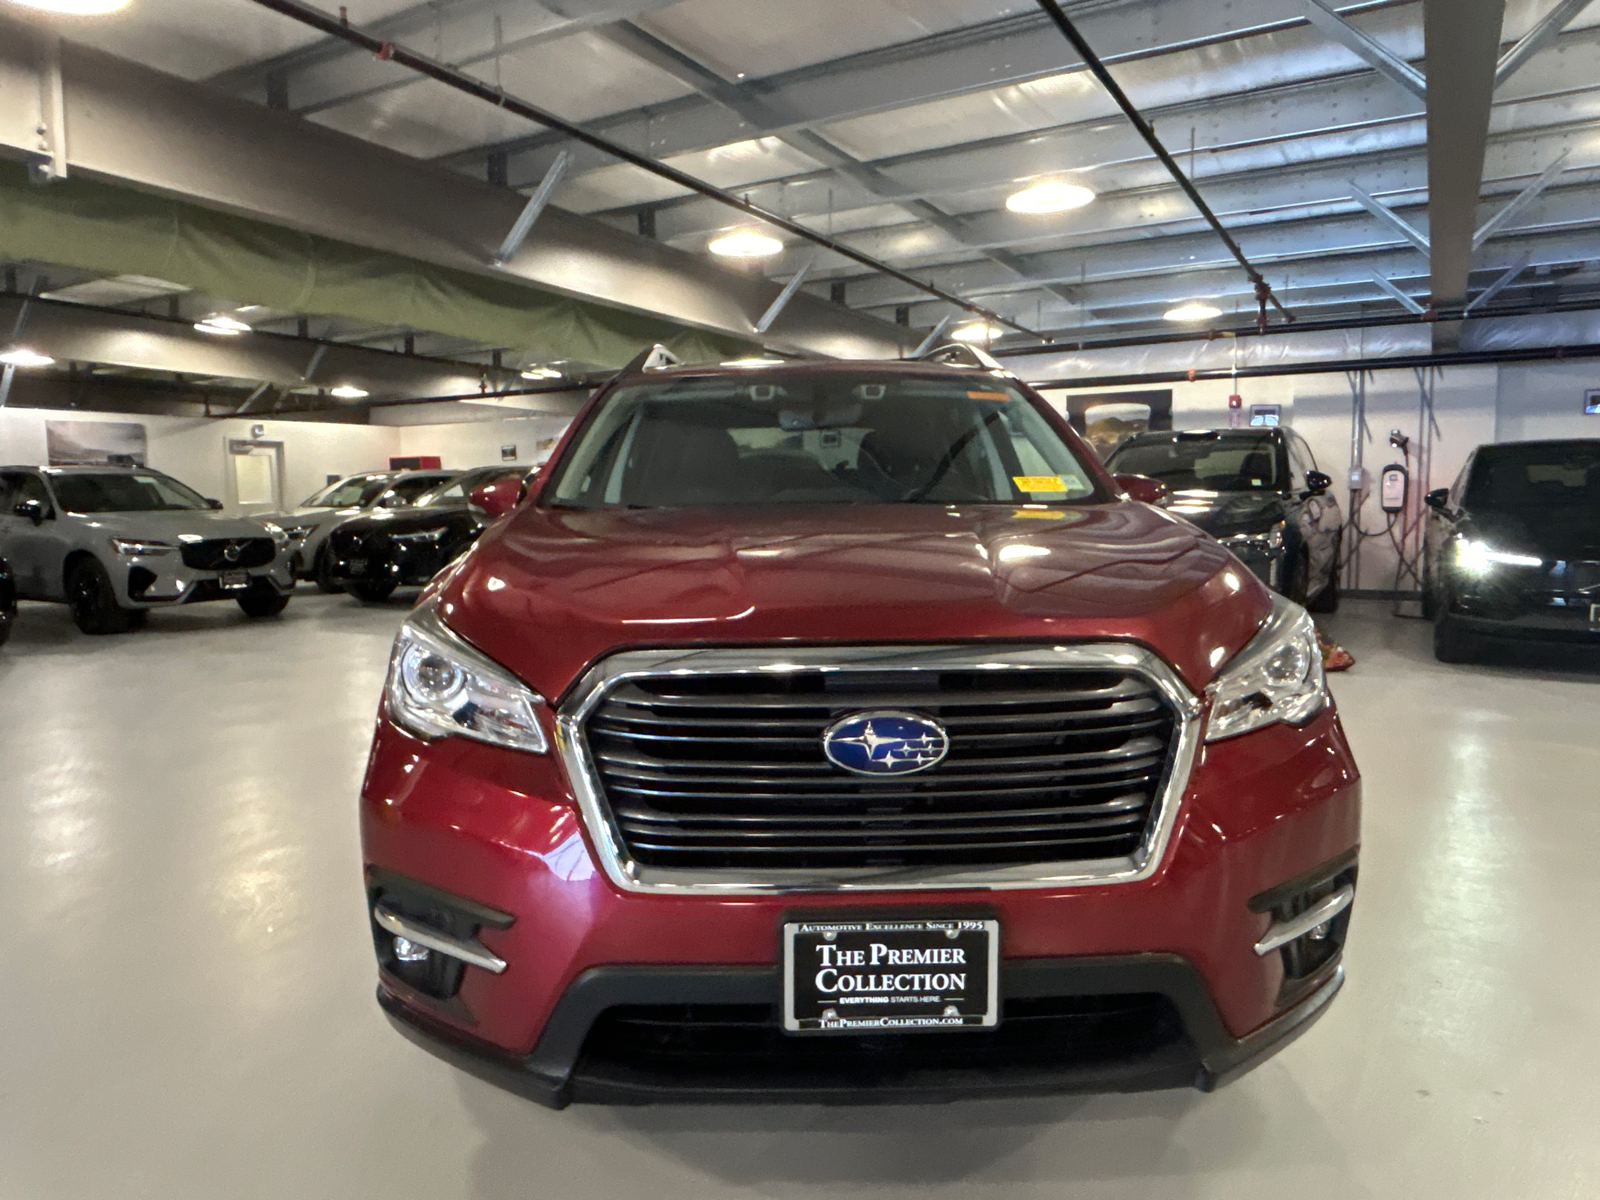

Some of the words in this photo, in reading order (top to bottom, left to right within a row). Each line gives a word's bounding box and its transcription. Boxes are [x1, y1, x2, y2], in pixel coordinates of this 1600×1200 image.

[800, 923, 862, 932] AUTOMOTIVE
[926, 921, 955, 930] SINCE
[957, 921, 984, 930] 1995
[816, 944, 866, 967] THE
[869, 943, 967, 966] PREMIER
[815, 968, 967, 993] COLLECTION
[839, 996, 889, 1004] EVERYTHING
